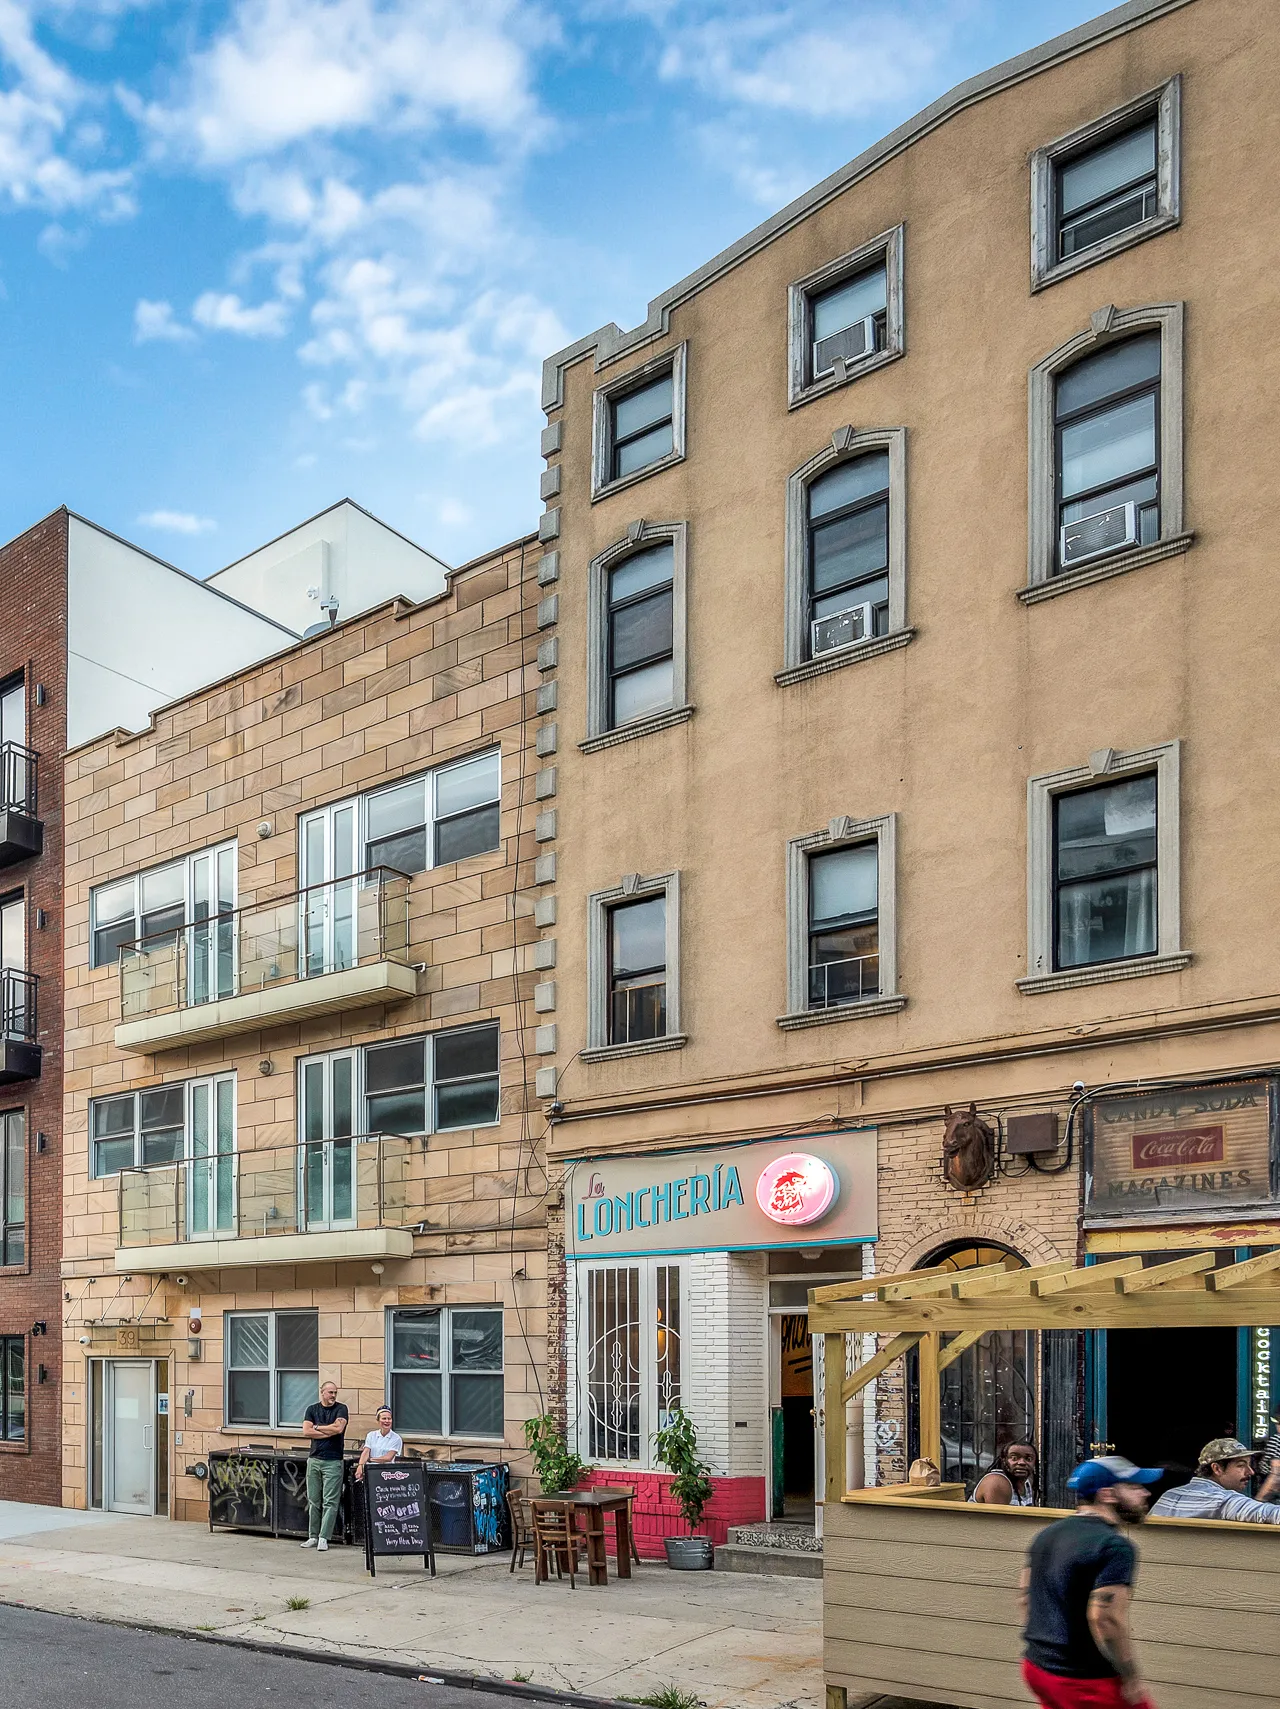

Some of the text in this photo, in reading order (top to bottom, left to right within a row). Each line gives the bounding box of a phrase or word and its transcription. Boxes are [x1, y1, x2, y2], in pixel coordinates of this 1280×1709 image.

[1102, 1092, 1258, 1124] CANDY SODA
[581, 1172, 606, 1200] La
[1107, 1169, 1252, 1199] MAGAZINES
[577, 1163, 745, 1242] LONCHERÍA
[119, 1330, 135, 1346] 39
[396, 1502, 420, 1517] OPEN
